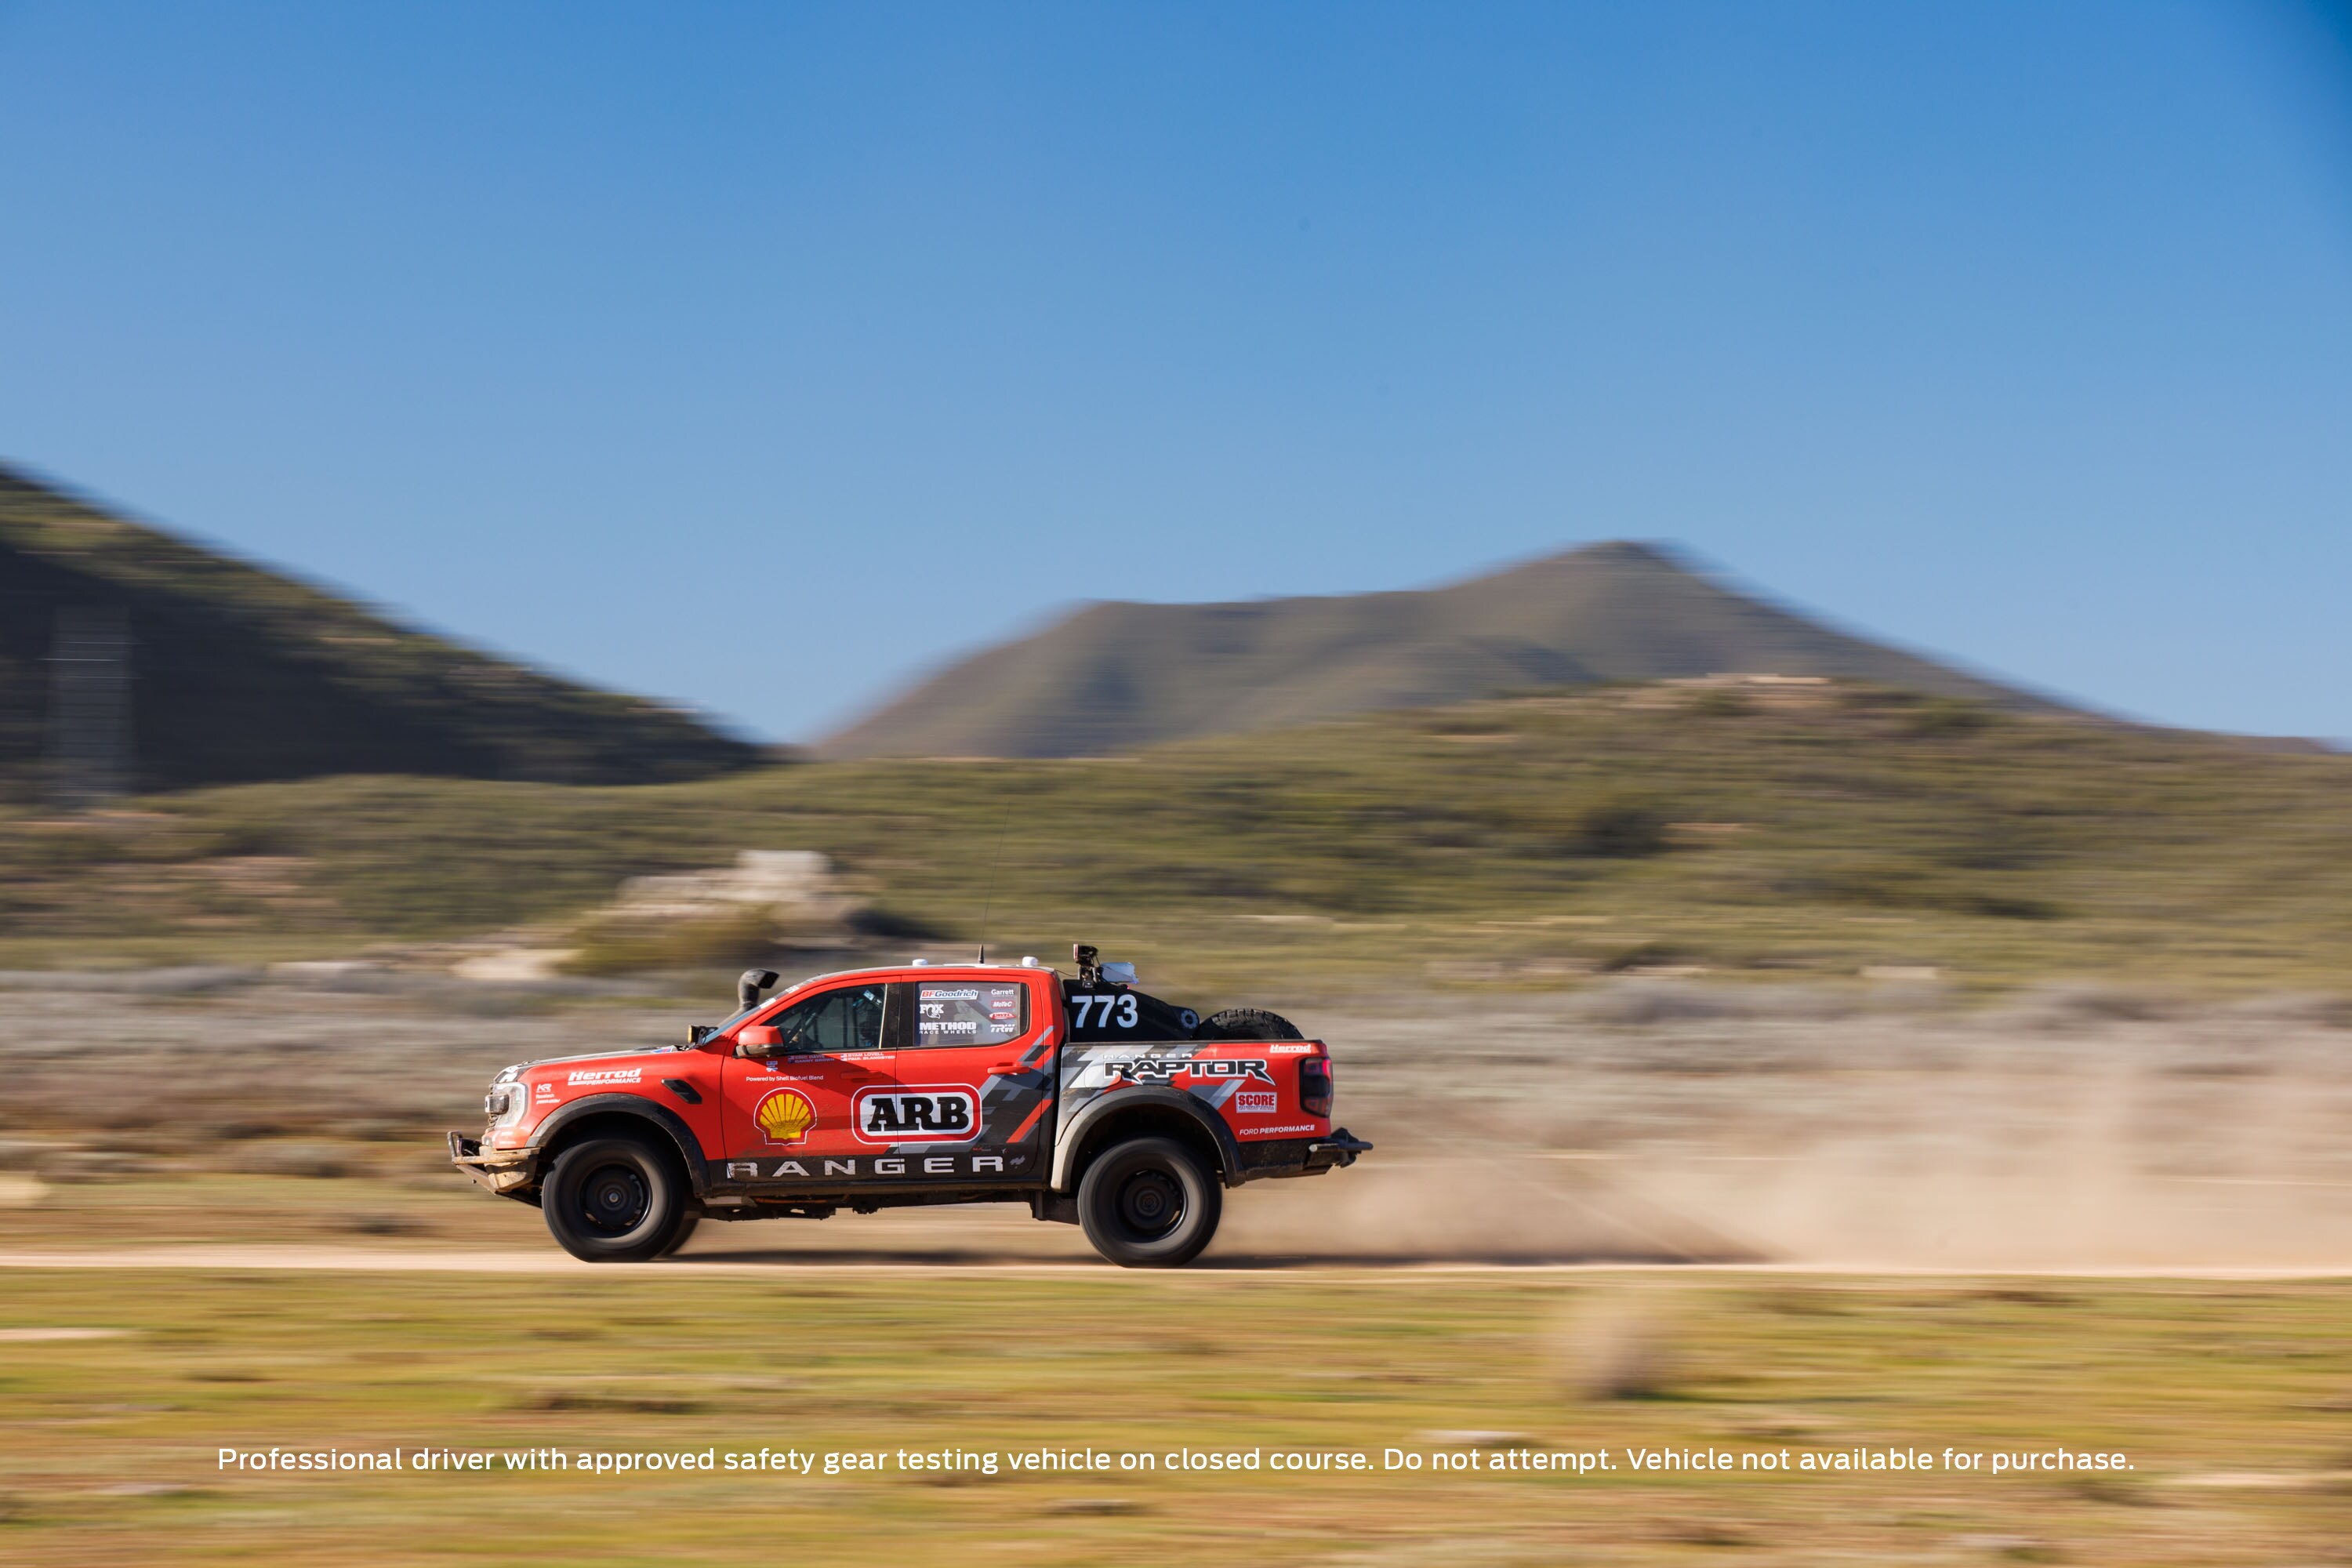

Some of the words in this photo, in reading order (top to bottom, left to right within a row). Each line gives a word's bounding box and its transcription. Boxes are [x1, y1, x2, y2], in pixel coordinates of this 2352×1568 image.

[920, 1004, 944, 1019] FOX
[1072, 994, 1138, 1029] 773
[919, 1022, 977, 1030] METHOD
[990, 1024, 1015, 1033] TRW
[1269, 1044, 1312, 1054] Herrod
[568, 1068, 642, 1081] Herrod
[1103, 1059, 1277, 1087] RAPTOR
[1238, 1094, 1275, 1106] SCORE
[867, 1096, 970, 1132] ARB
[1259, 1124, 1316, 1134] PERFORMANCE
[726, 1155, 1004, 1180] RANGER
